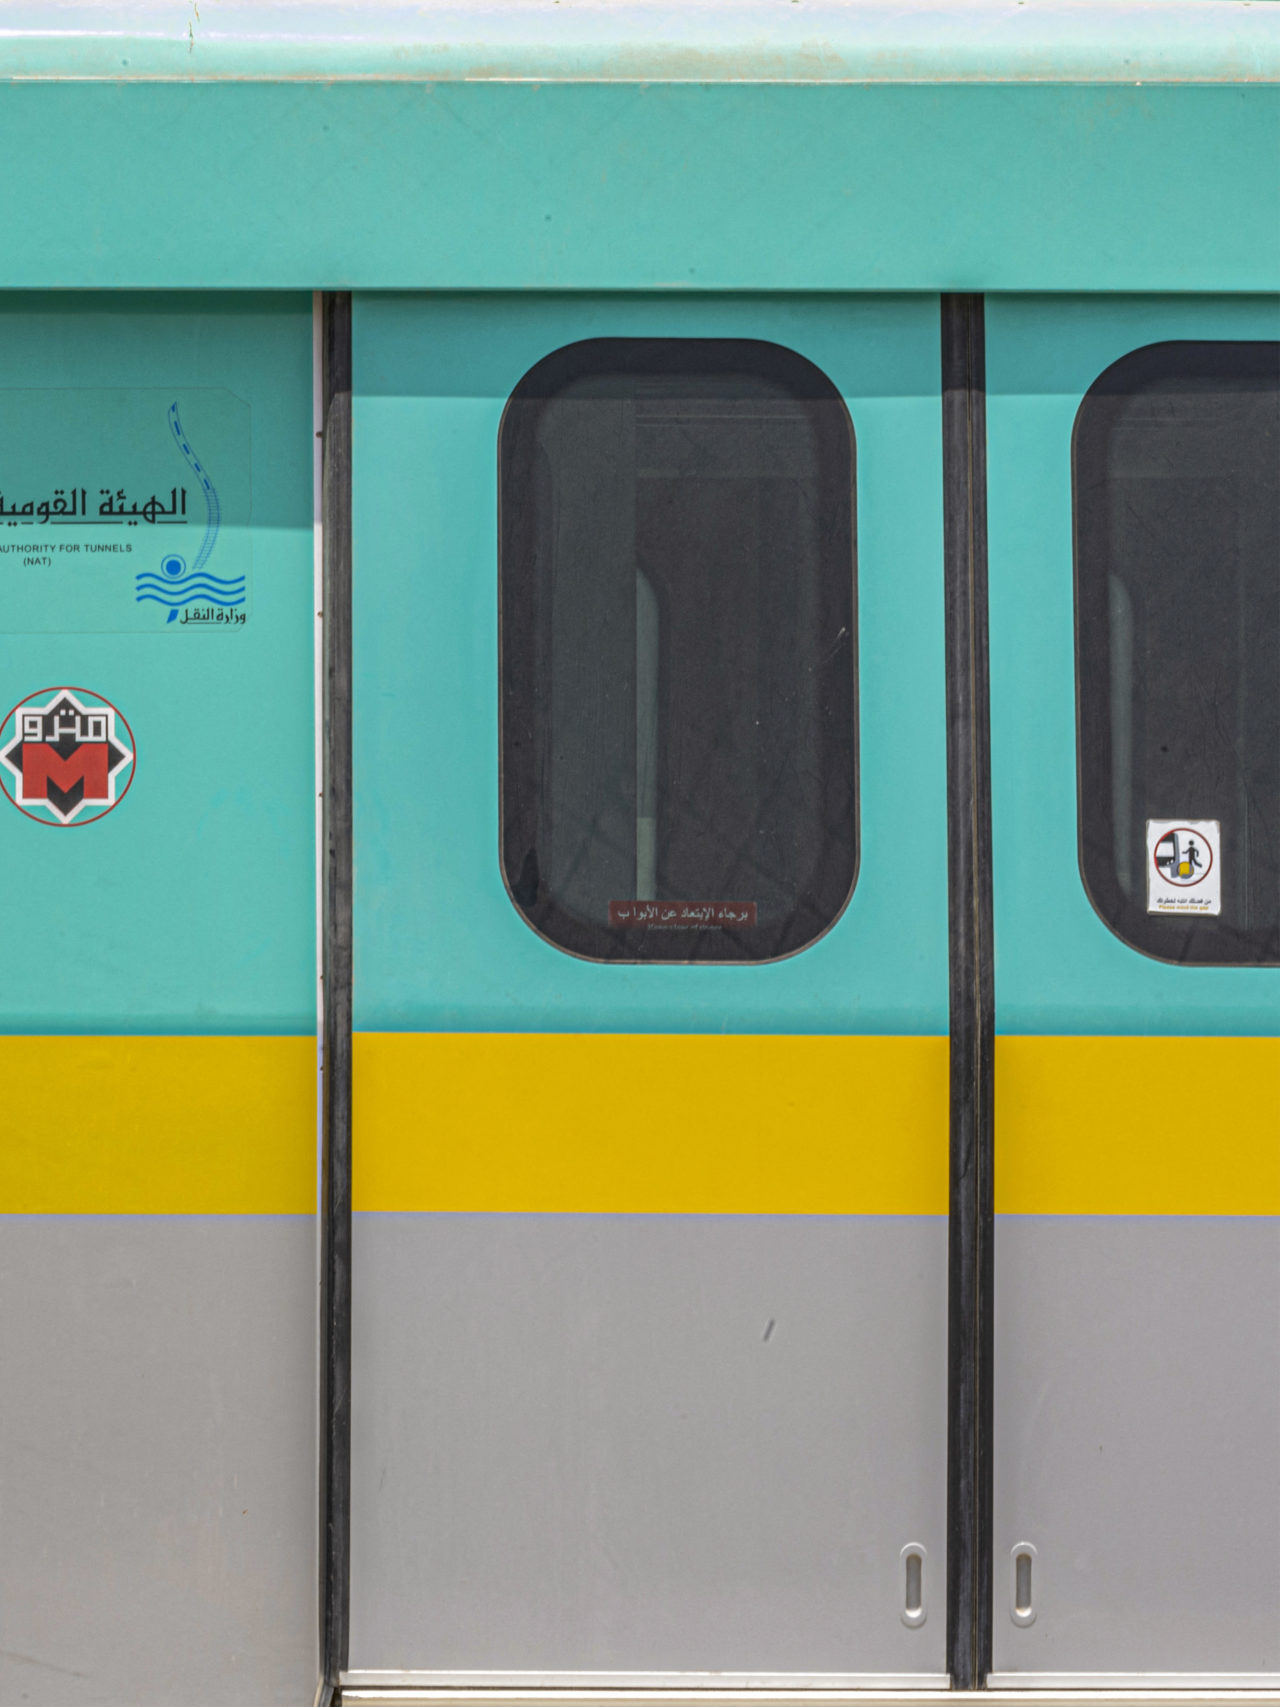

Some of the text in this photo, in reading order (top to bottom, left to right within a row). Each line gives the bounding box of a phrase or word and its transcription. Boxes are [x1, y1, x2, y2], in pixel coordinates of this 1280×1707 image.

[98, 487, 188, 527] الهيئة
[59, 543, 81, 553] FOR
[83, 543, 133, 553] TUNNELS
[22, 556, 52, 567] (NAT)
[179, 607, 247, 625] وزارة النقل
[660, 908, 677, 920] عن
